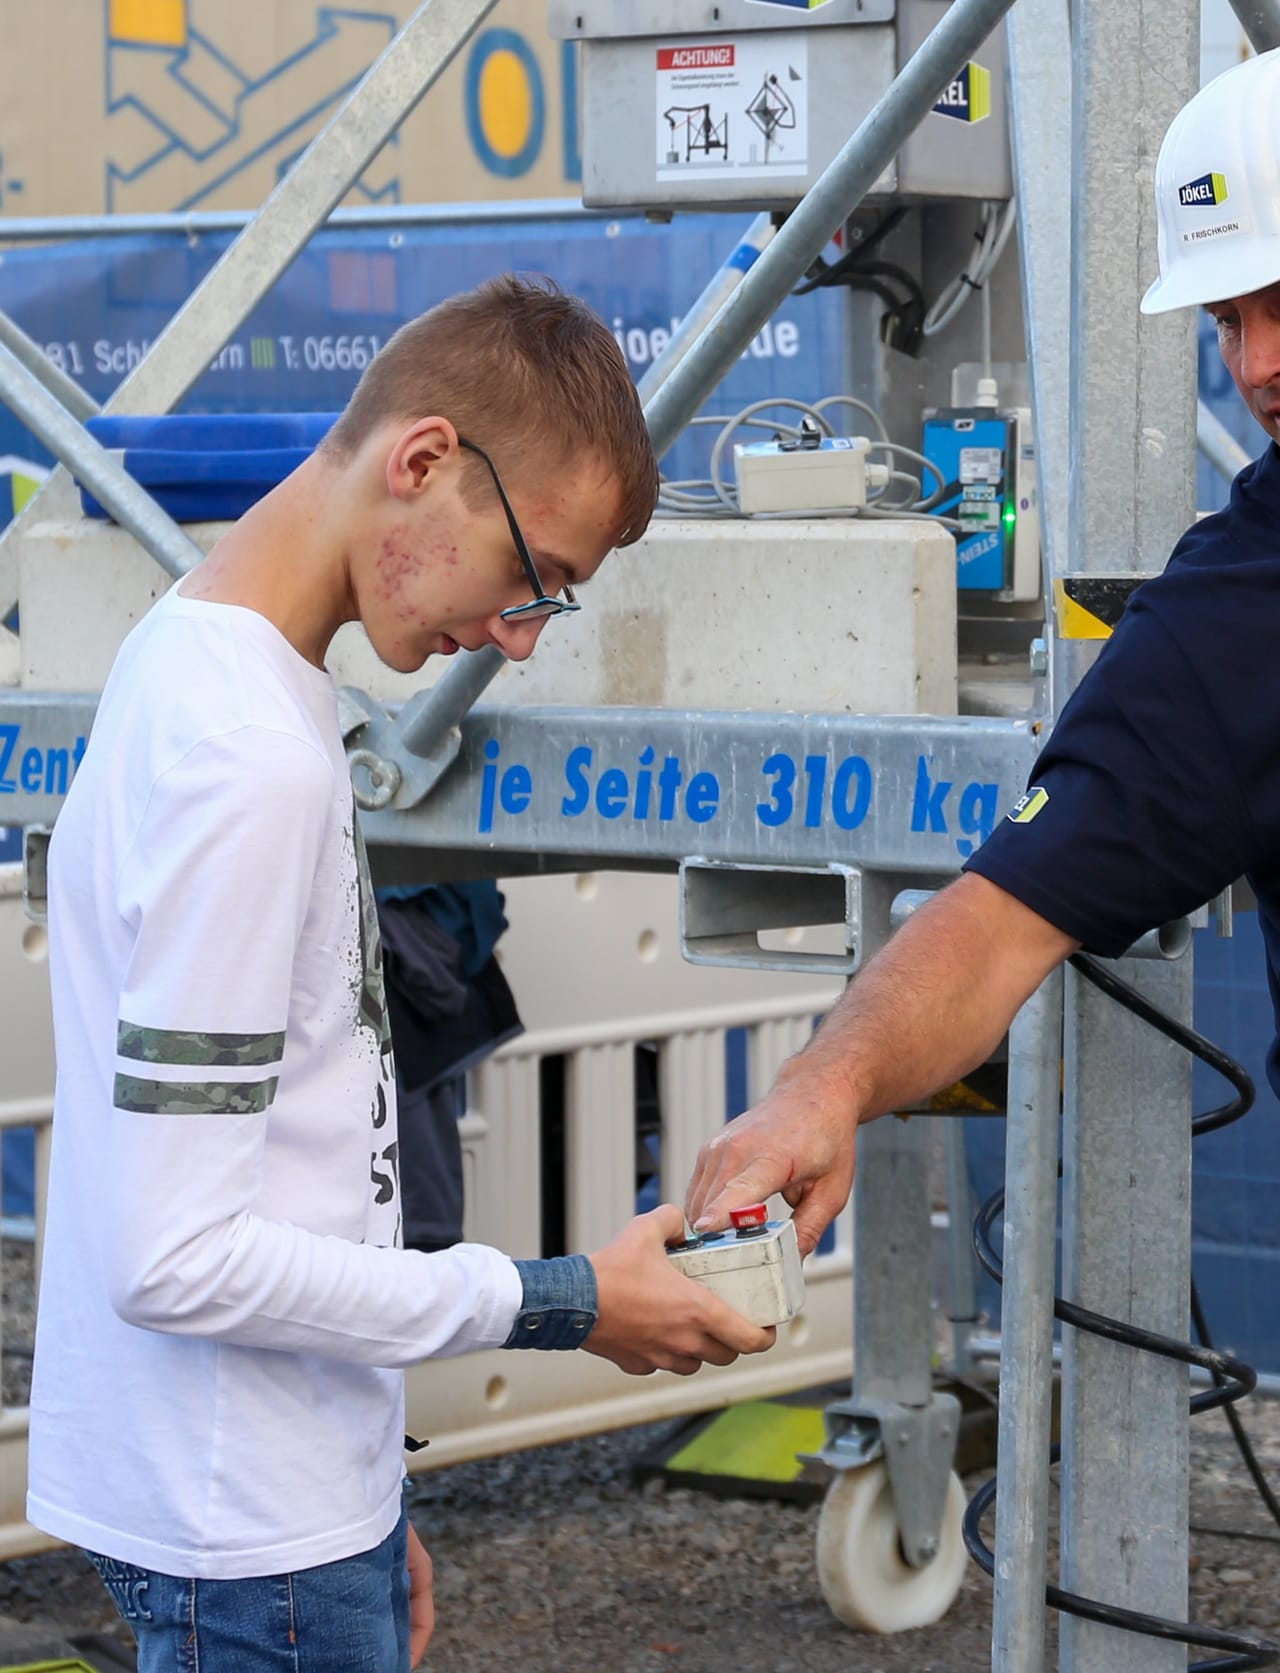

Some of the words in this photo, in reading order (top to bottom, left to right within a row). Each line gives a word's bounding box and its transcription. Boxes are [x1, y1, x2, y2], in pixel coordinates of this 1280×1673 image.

[671, 49, 731, 67] ACHTUNG!
[1181, 183, 1213, 204] JÖKEL
[1191, 222, 1240, 240] FRISCHKORN
[279, 335, 299, 369] T:
[478, 738, 533, 834] je
[561, 745, 721, 824] Seite
[756, 752, 873, 831] 310
[910, 754, 1000, 859] kg
